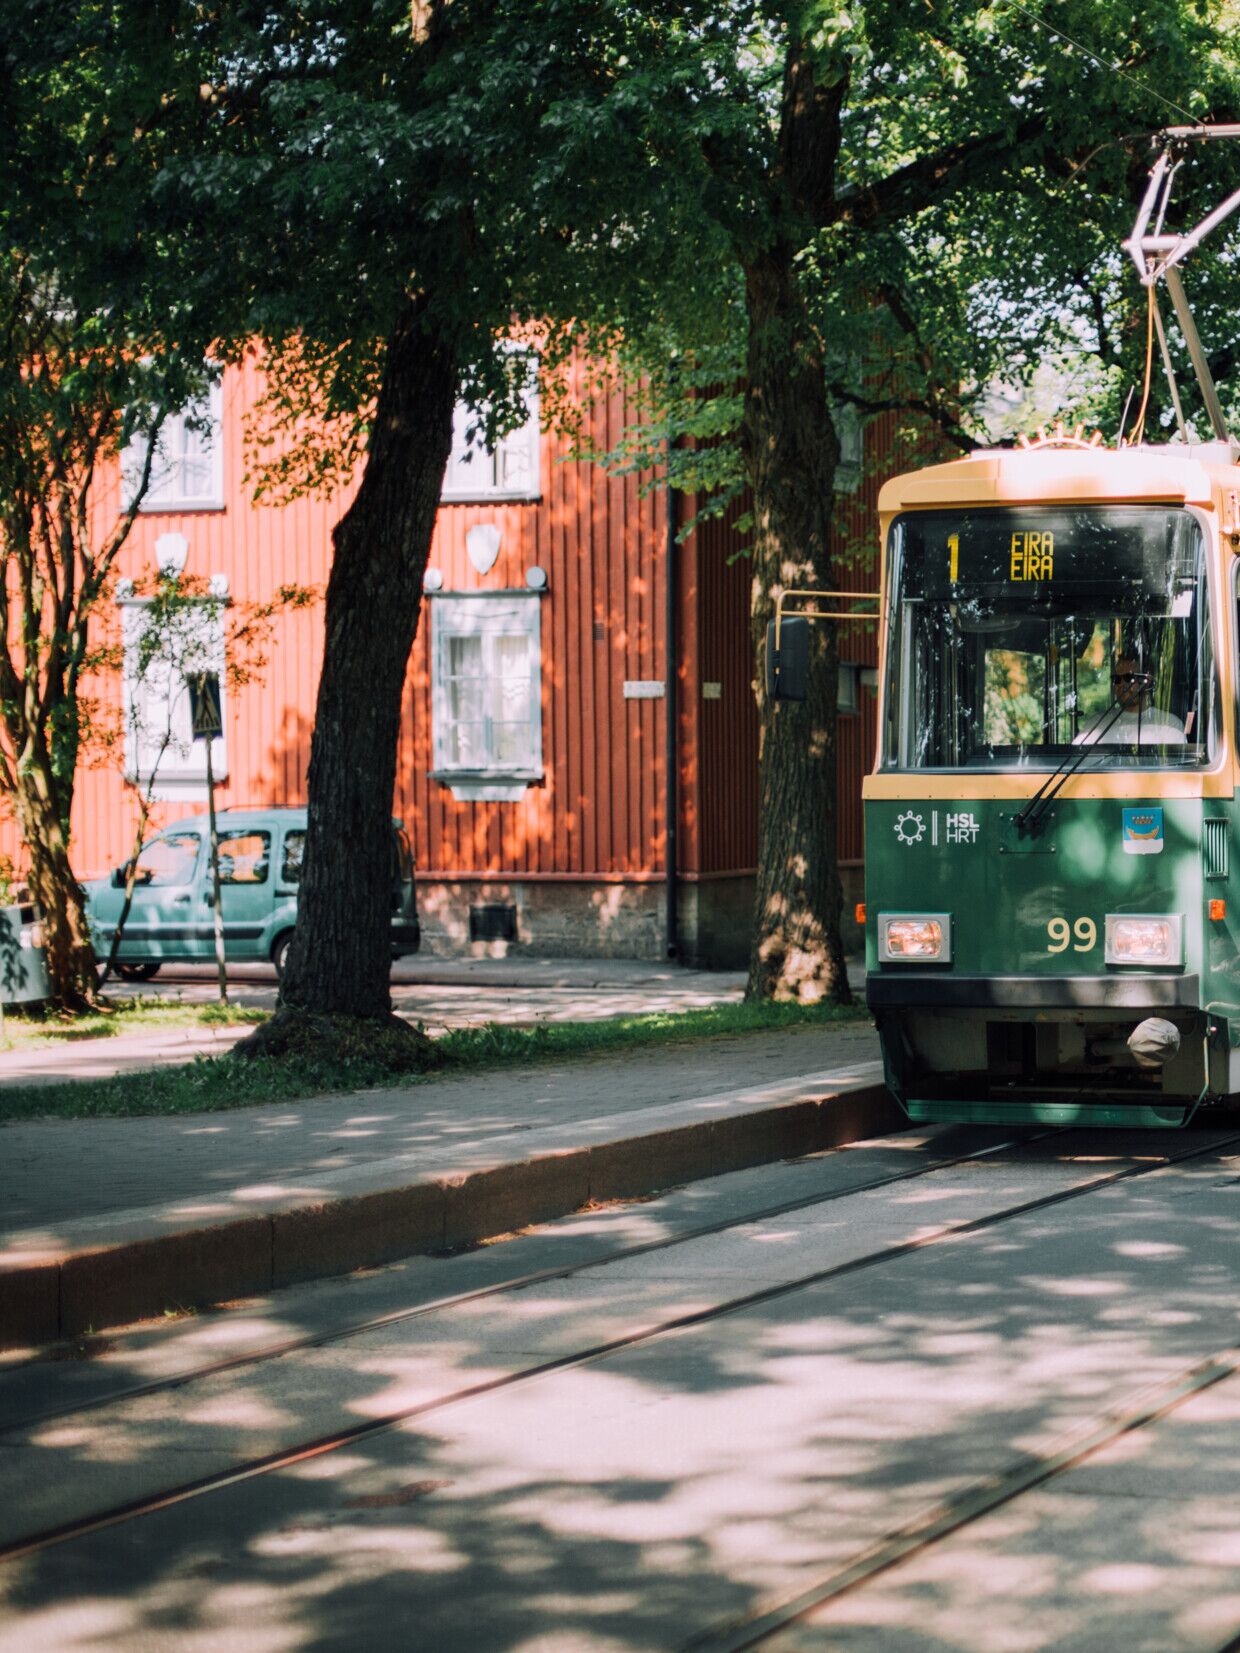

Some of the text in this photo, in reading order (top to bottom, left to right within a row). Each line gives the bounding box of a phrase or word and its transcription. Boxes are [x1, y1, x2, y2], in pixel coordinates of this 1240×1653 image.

[1011, 530, 1054, 556] EIRA
[947, 532, 959, 584] 1
[1010, 555, 1053, 581] EIRA
[946, 813, 980, 828] HSL
[946, 828, 980, 843] HRT
[1047, 916, 1097, 953] 99
